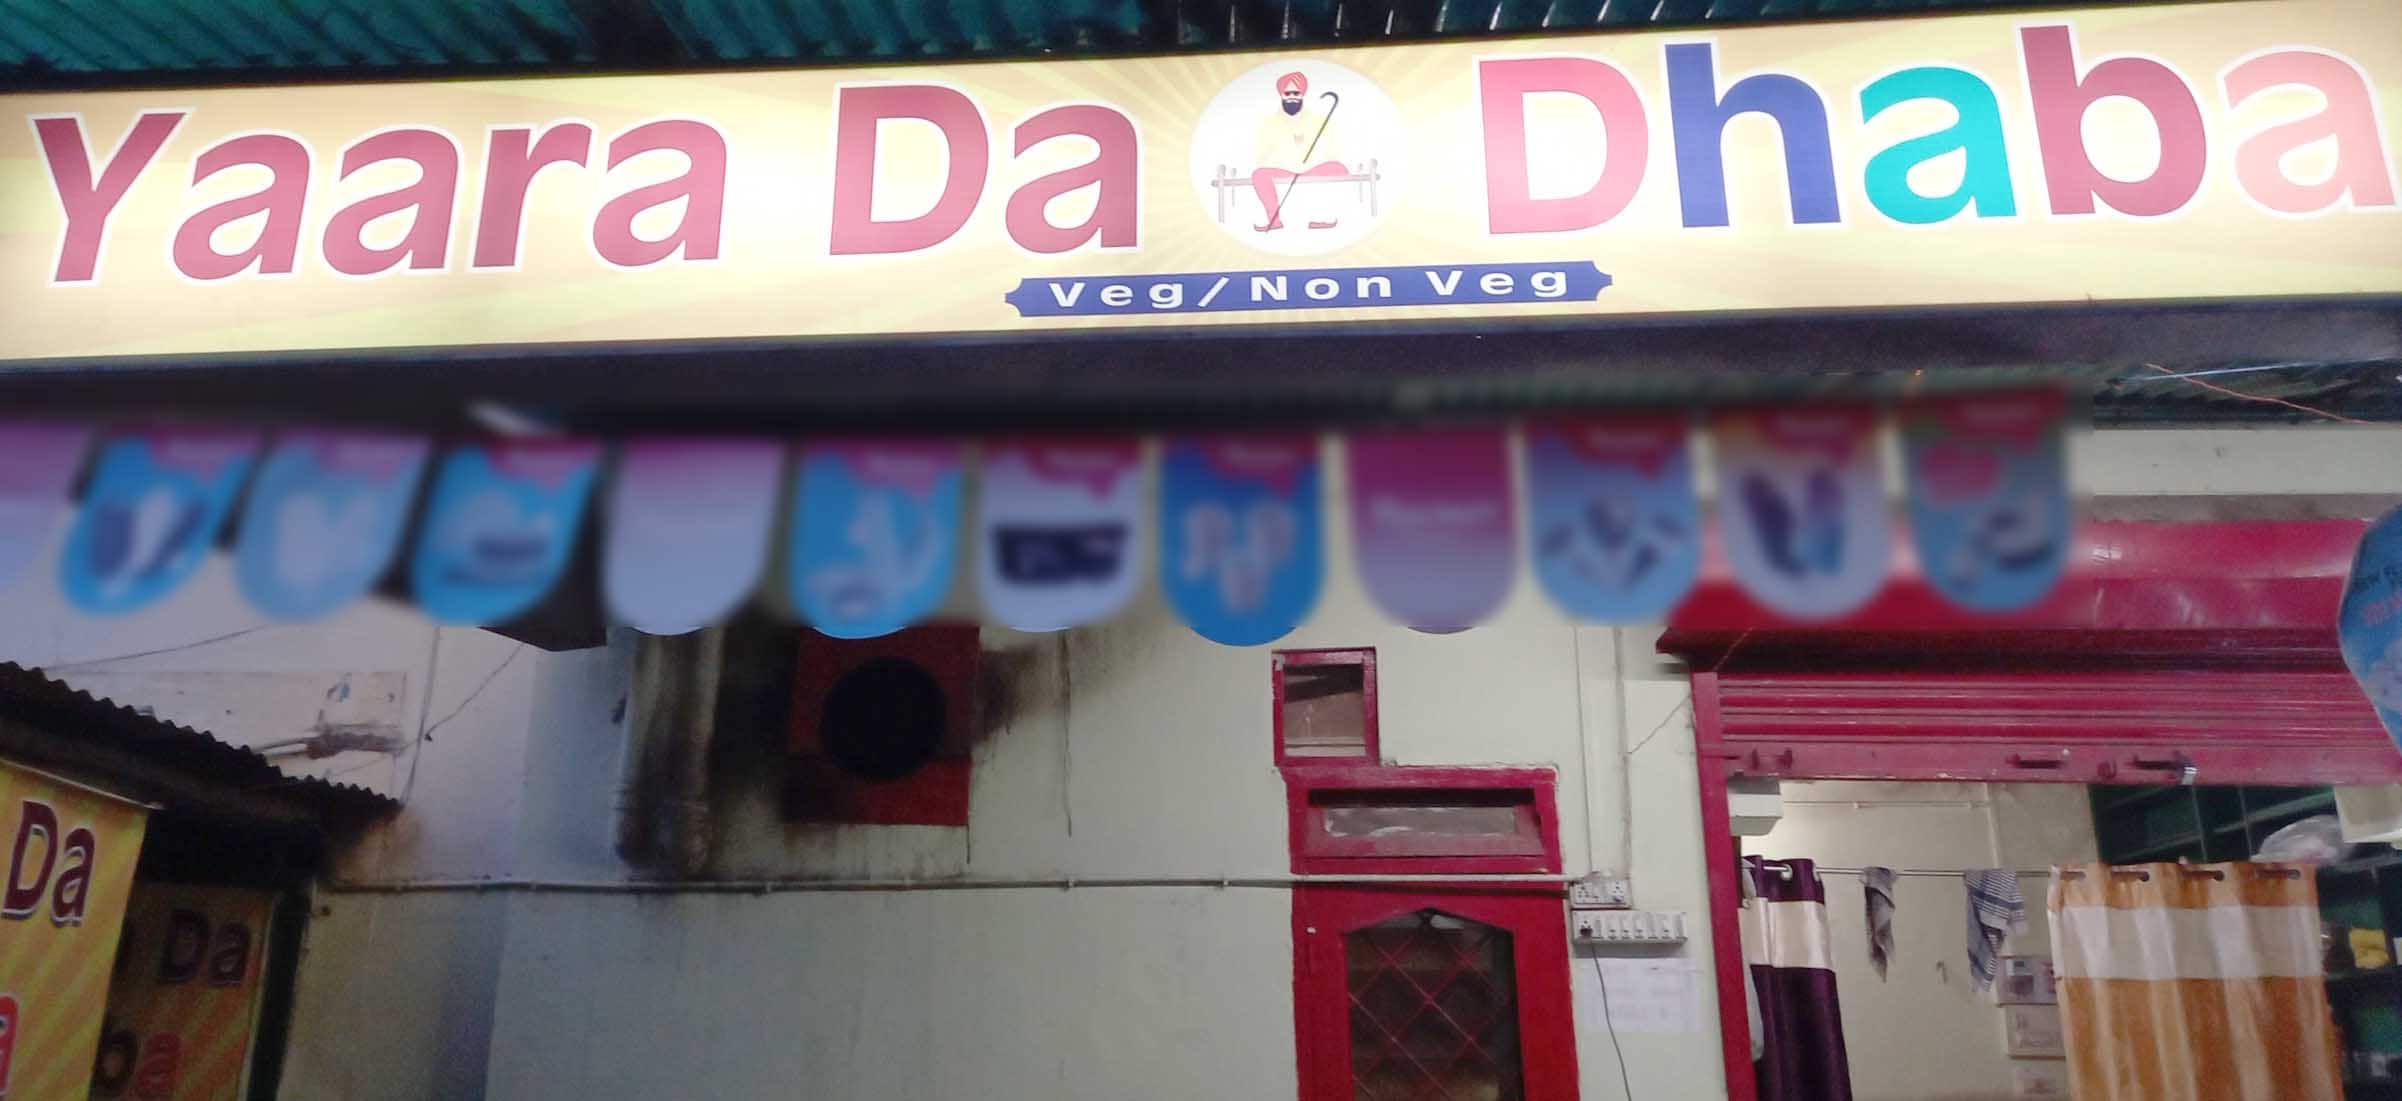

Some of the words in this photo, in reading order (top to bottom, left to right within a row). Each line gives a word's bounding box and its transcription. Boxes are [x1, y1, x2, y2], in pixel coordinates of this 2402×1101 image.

[32, 112, 729, 283] Yaara
[829, 84, 1138, 255] Da
[1476, 25, 2395, 235] Dhaba
[1427, 269, 1570, 300] Veg
[2, 801, 96, 925] Da
[162, 909, 251, 986] Da
